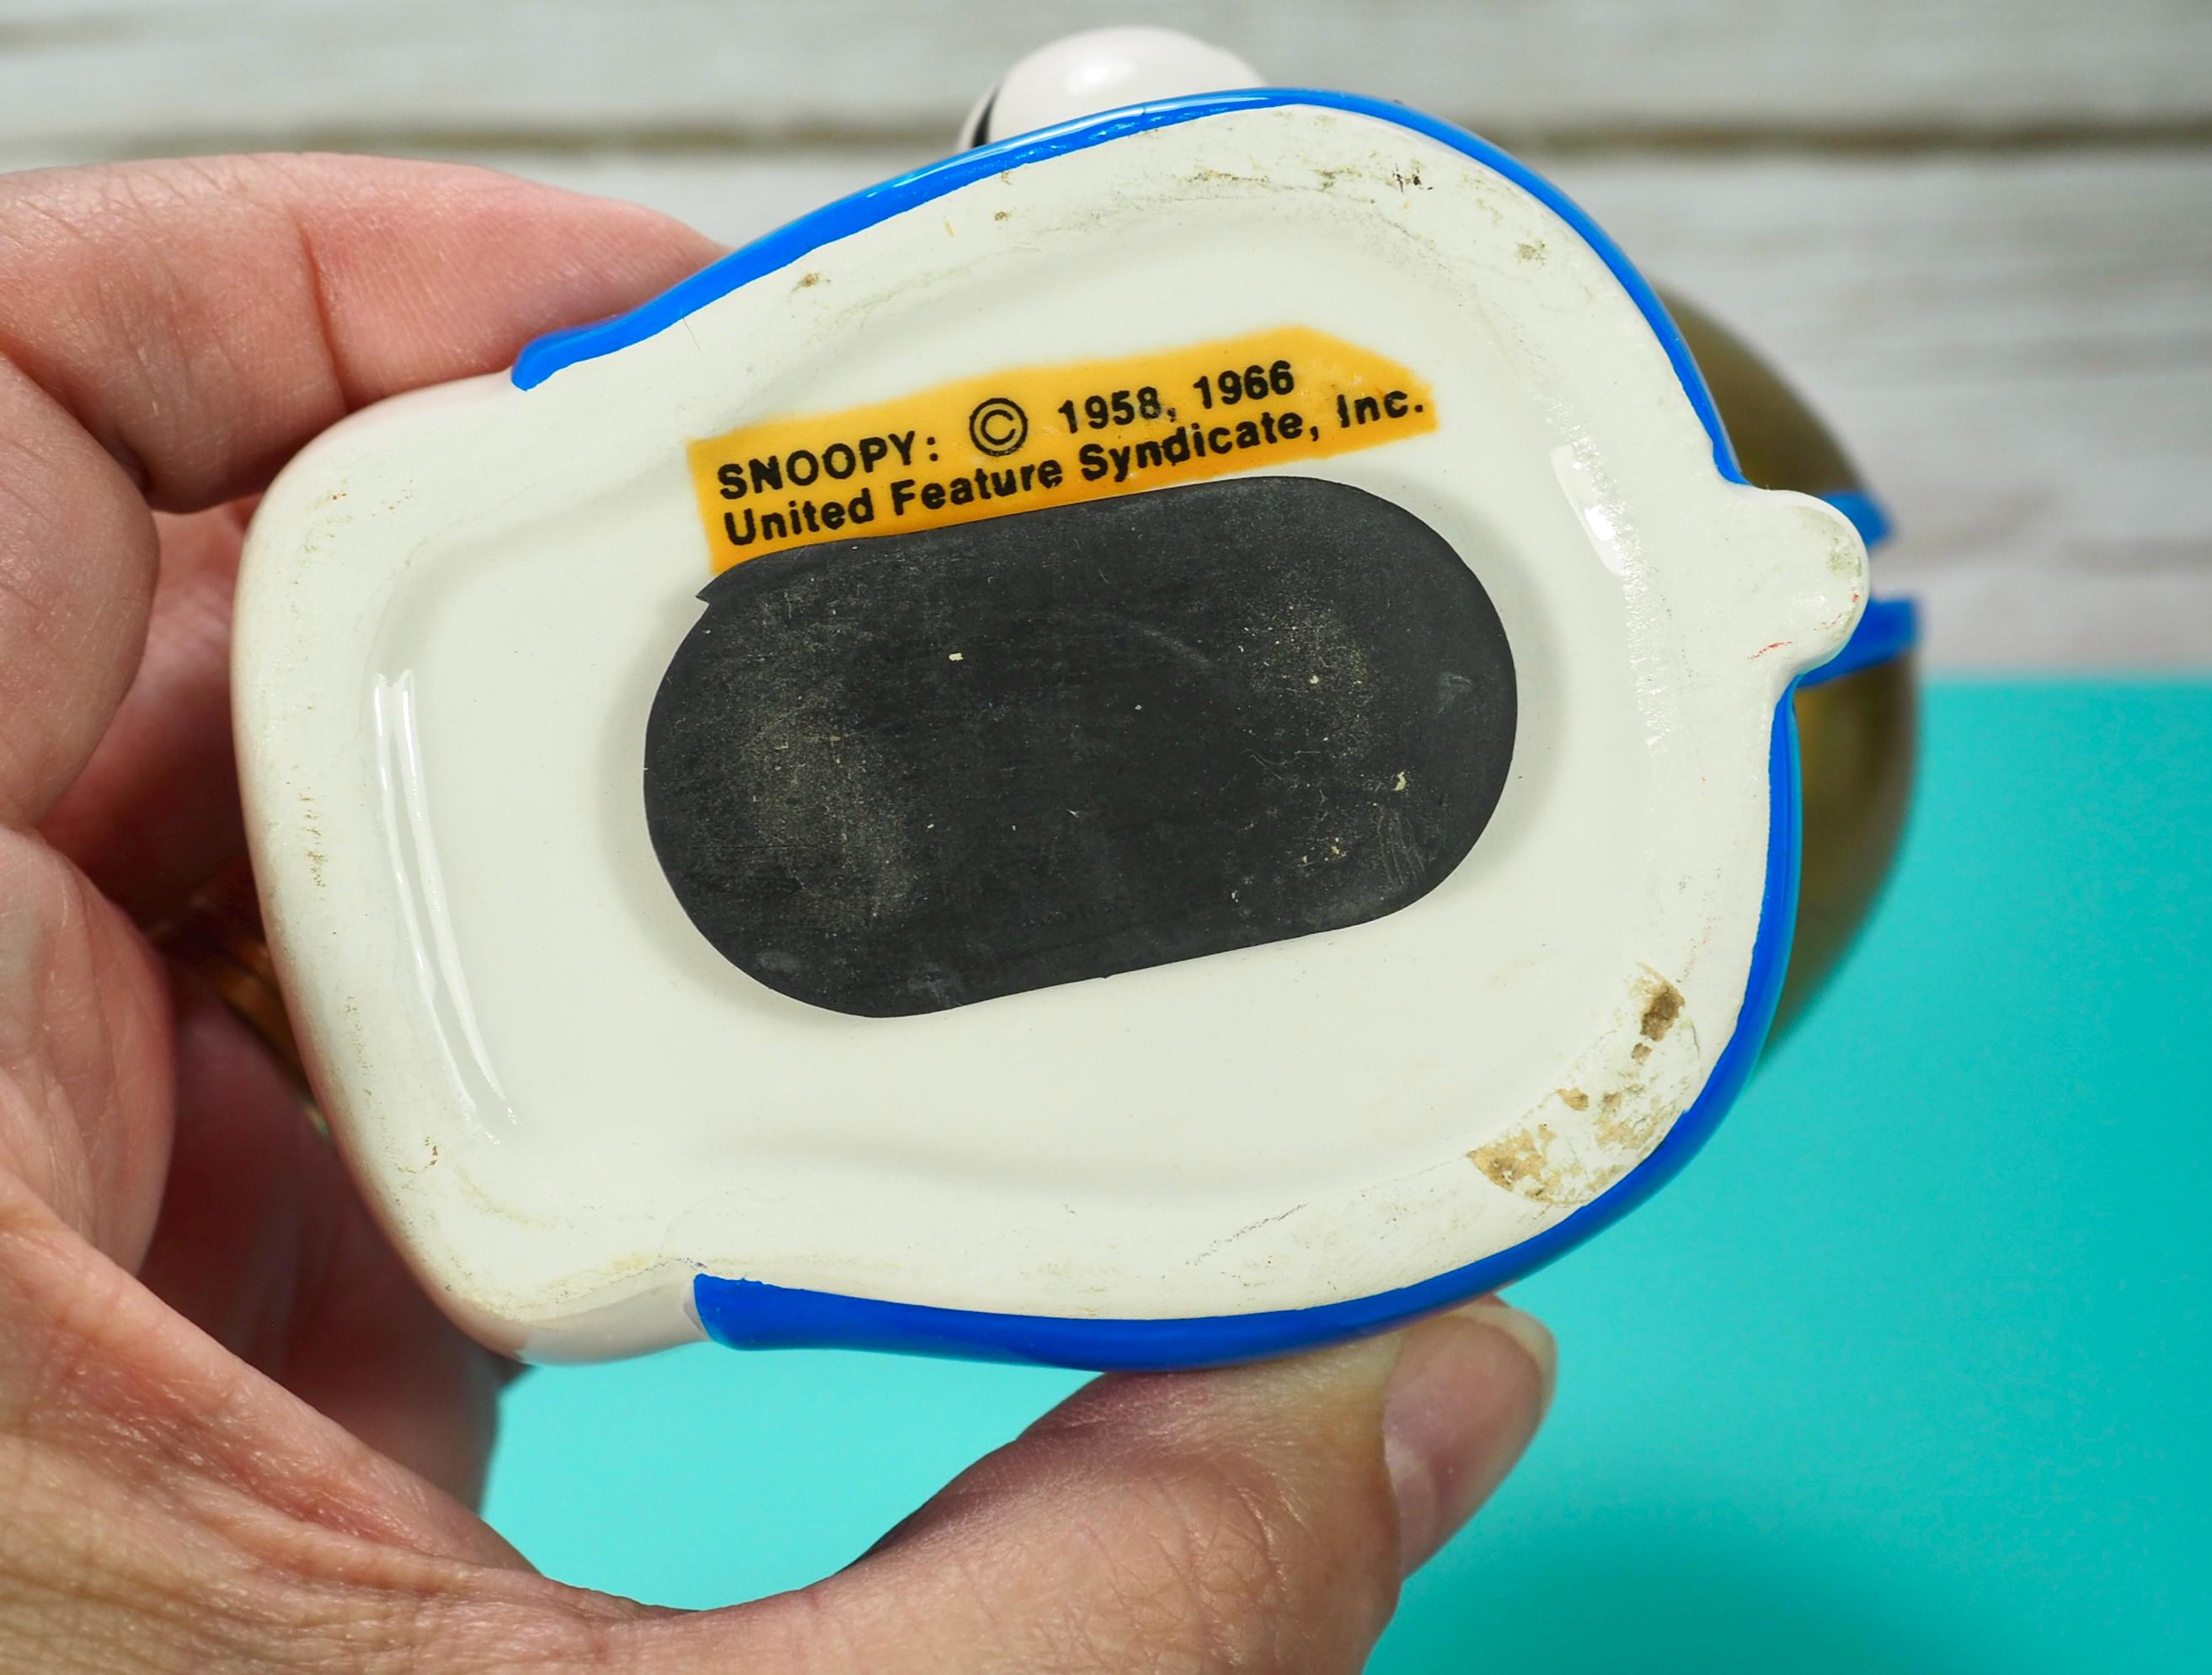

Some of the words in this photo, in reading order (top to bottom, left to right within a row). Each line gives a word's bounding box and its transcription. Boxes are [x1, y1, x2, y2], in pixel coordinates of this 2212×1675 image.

[717, 430, 938, 500] SNOOPY:
[1058, 386, 1178, 435] 1958,
[1193, 360, 1295, 410] 1966
[724, 487, 875, 547] United
[890, 459, 1064, 516] Feature
[1078, 411, 1320, 483] Syndicate,
[1337, 390, 1424, 429] Inc.
